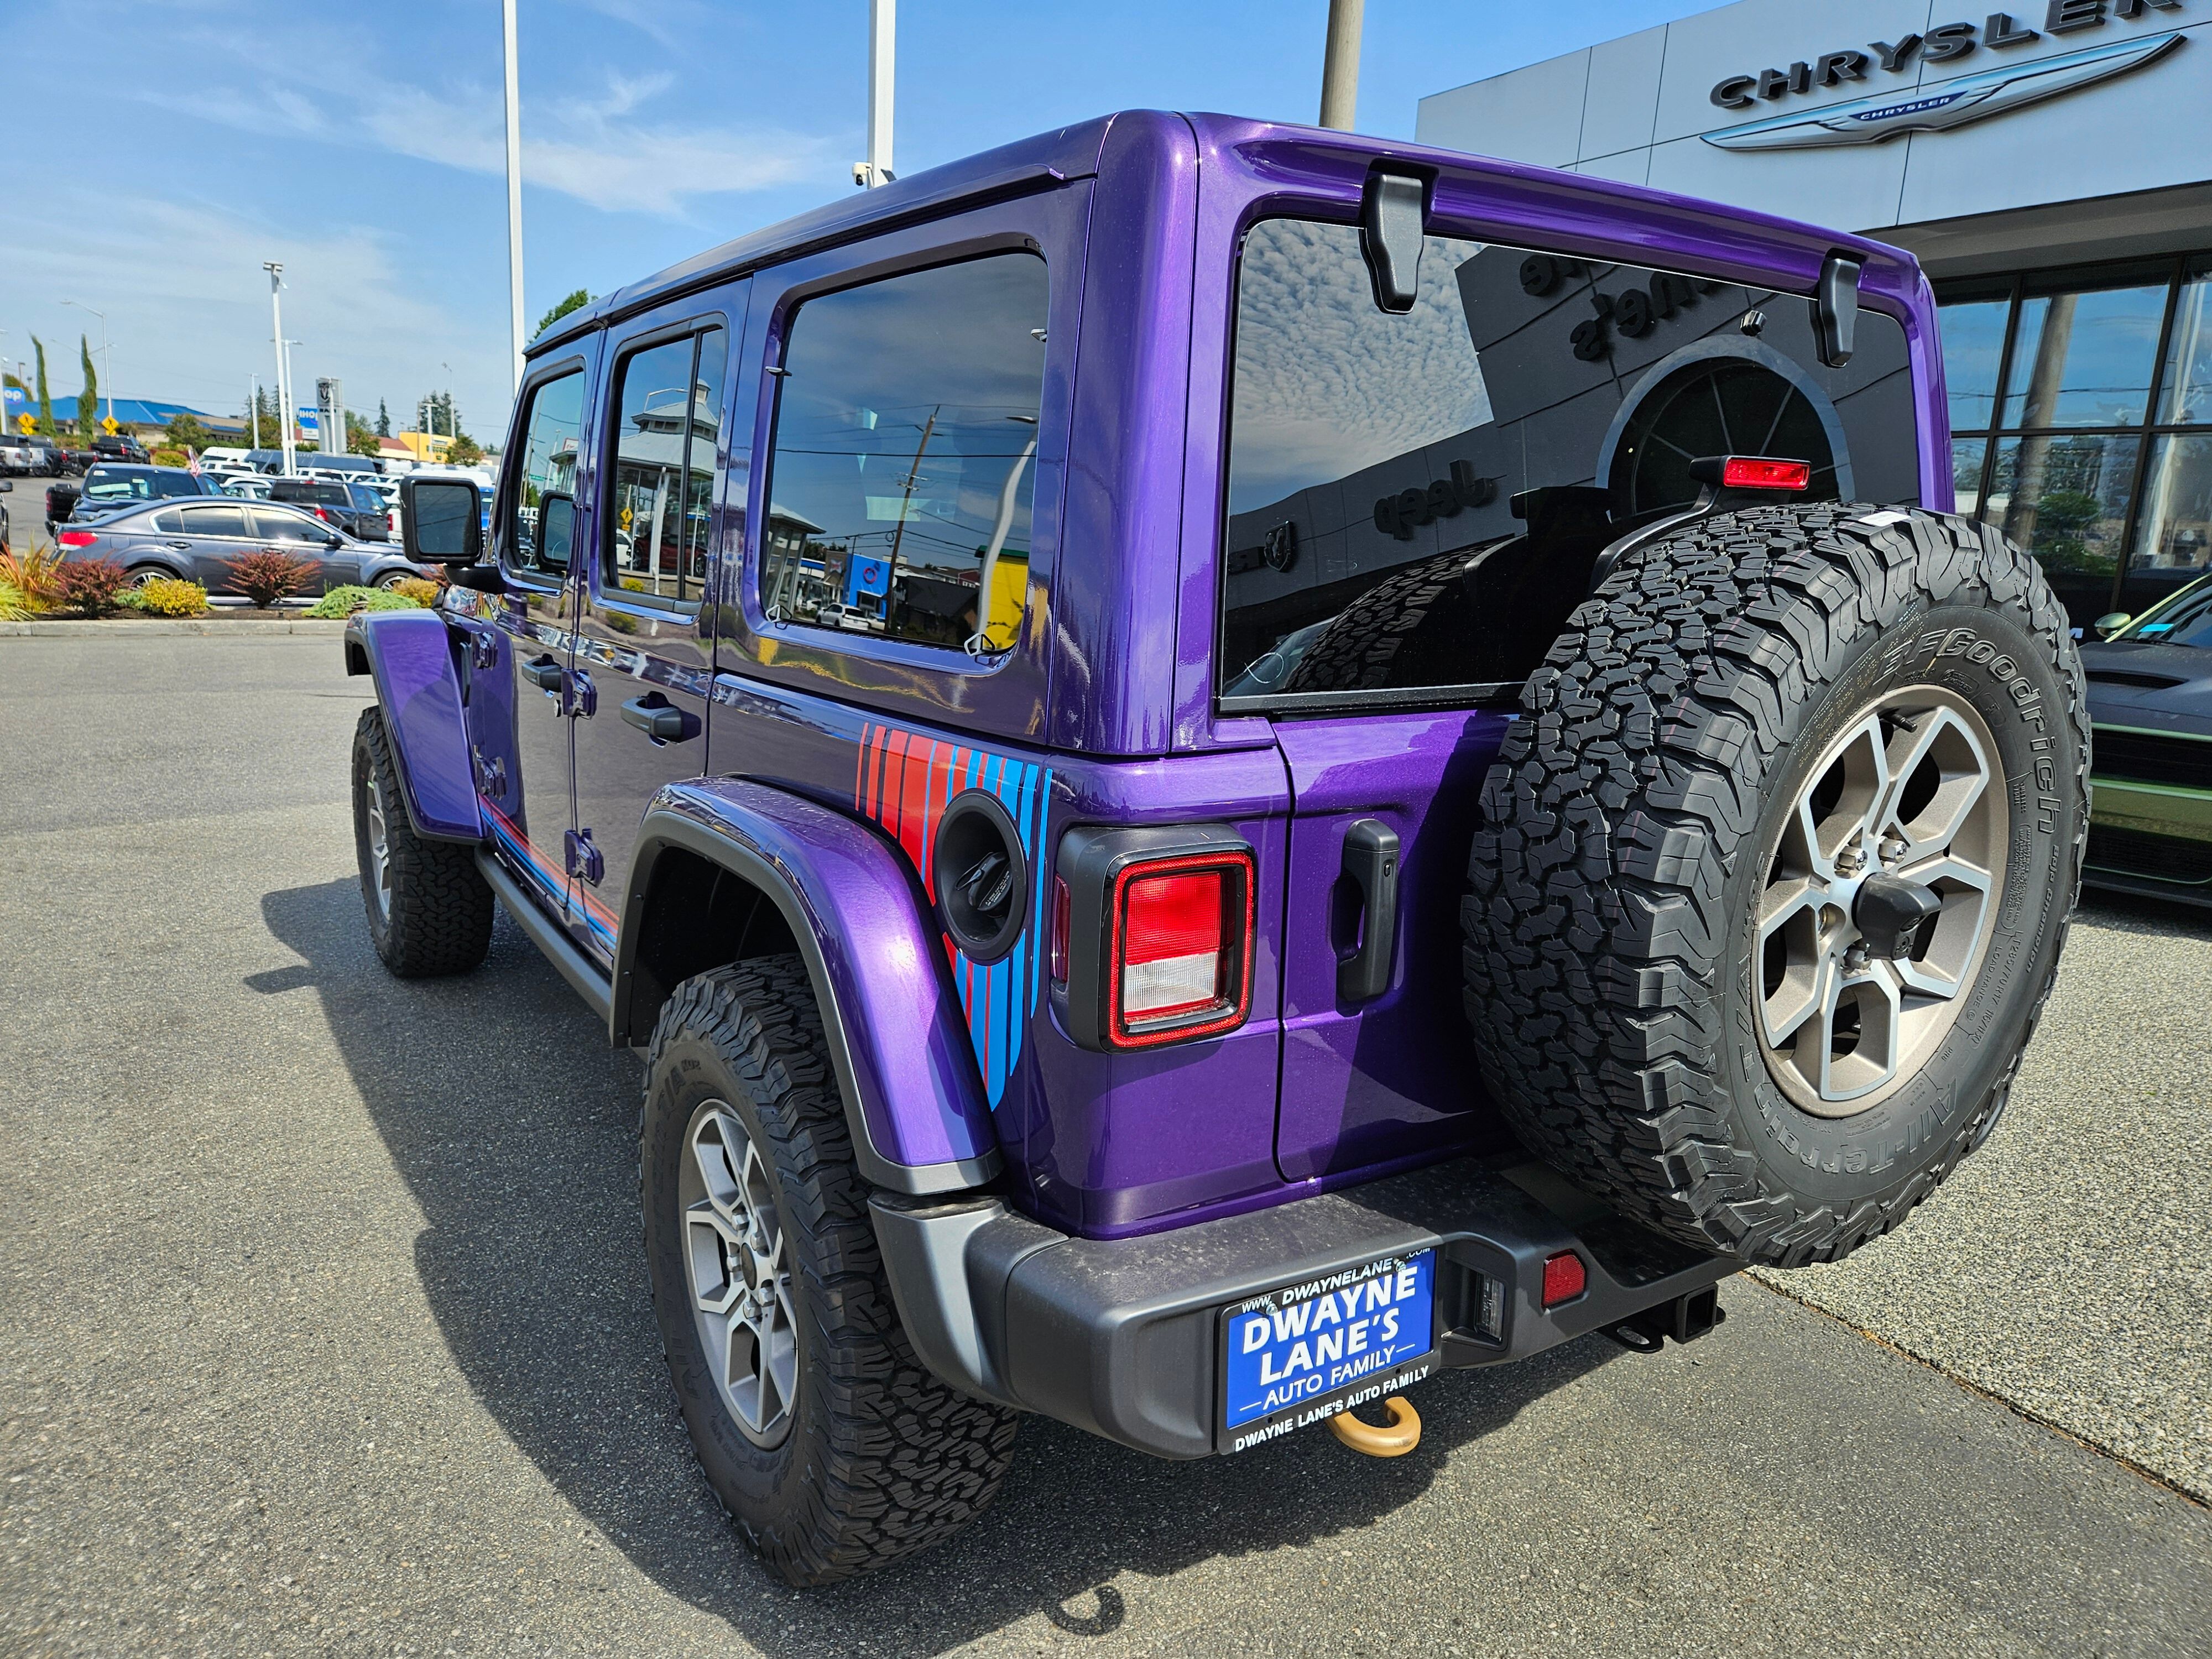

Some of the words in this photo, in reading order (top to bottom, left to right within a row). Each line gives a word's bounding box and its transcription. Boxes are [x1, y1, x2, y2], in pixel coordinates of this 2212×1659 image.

[1860, 96, 1950, 121] CHRYSLER
[1872, 628, 2062, 834] BFGoodrich
[2049, 845, 2060, 883] Baja
[1988, 946, 2003, 973] LOAD
[2026, 888, 2053, 974] Champion
[1973, 974, 1992, 1008] RANGE
[1754, 1075, 1957, 1175] All-Terrain
[1243, 1266, 1418, 1355] DWAYNE
[1260, 1307, 1400, 1386] LANE'S
[1235, 1420, 1294, 1453] DWAYNE
[1297, 1399, 1344, 1428] LANE'S
[1345, 1384, 1381, 1410] AUTO
[1383, 1365, 1429, 1395] FAMILY
[1262, 1372, 1323, 1411] AUTO
[1330, 1344, 1396, 1386] FAMILY
